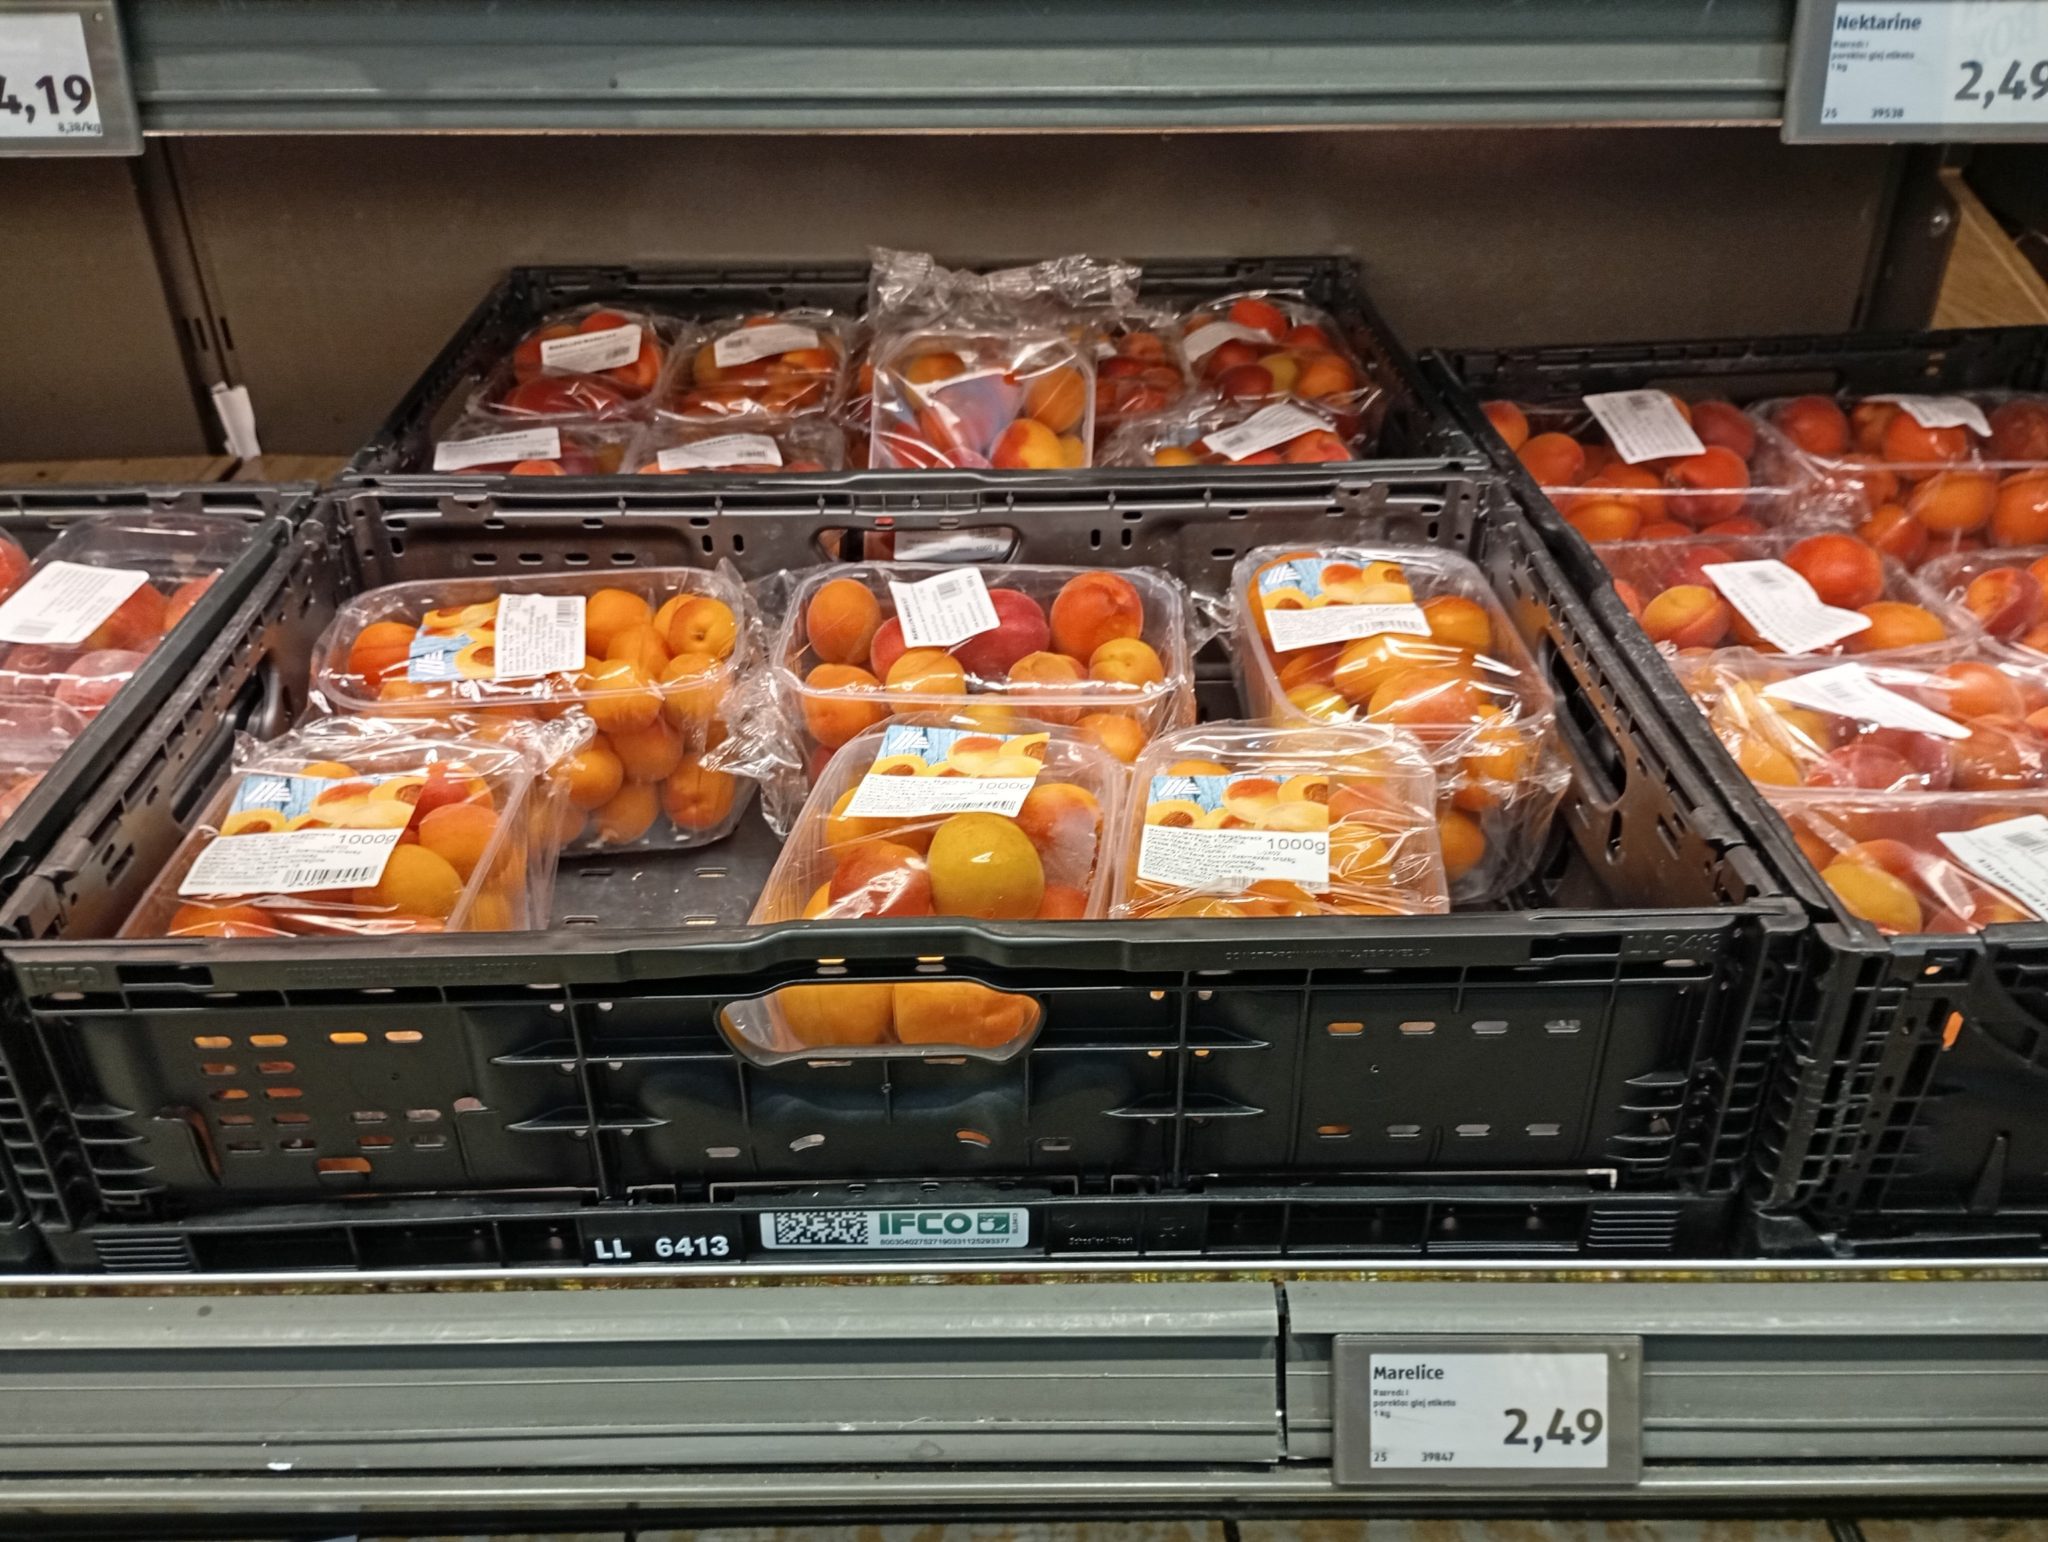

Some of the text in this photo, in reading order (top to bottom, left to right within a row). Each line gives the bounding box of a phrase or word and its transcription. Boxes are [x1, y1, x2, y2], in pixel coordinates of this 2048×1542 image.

[1836, 12, 1922, 31] Nektarine
[1954, 59, 2048, 109] 2,49
[0, 74, 92, 124] 4,19
[1824, 107, 1838, 118] 25
[338, 834, 397, 845] 1000g
[1266, 838, 1327, 855] 1000g
[879, 1212, 972, 1235] IFCO
[594, 1235, 730, 1259] LL 6413
[1373, 1364, 1445, 1380] Marelice
[1380, 1410, 1391, 1419] kg
[1503, 1407, 1604, 1453] 2,49
[1373, 1451, 1455, 1462] 25 39847
